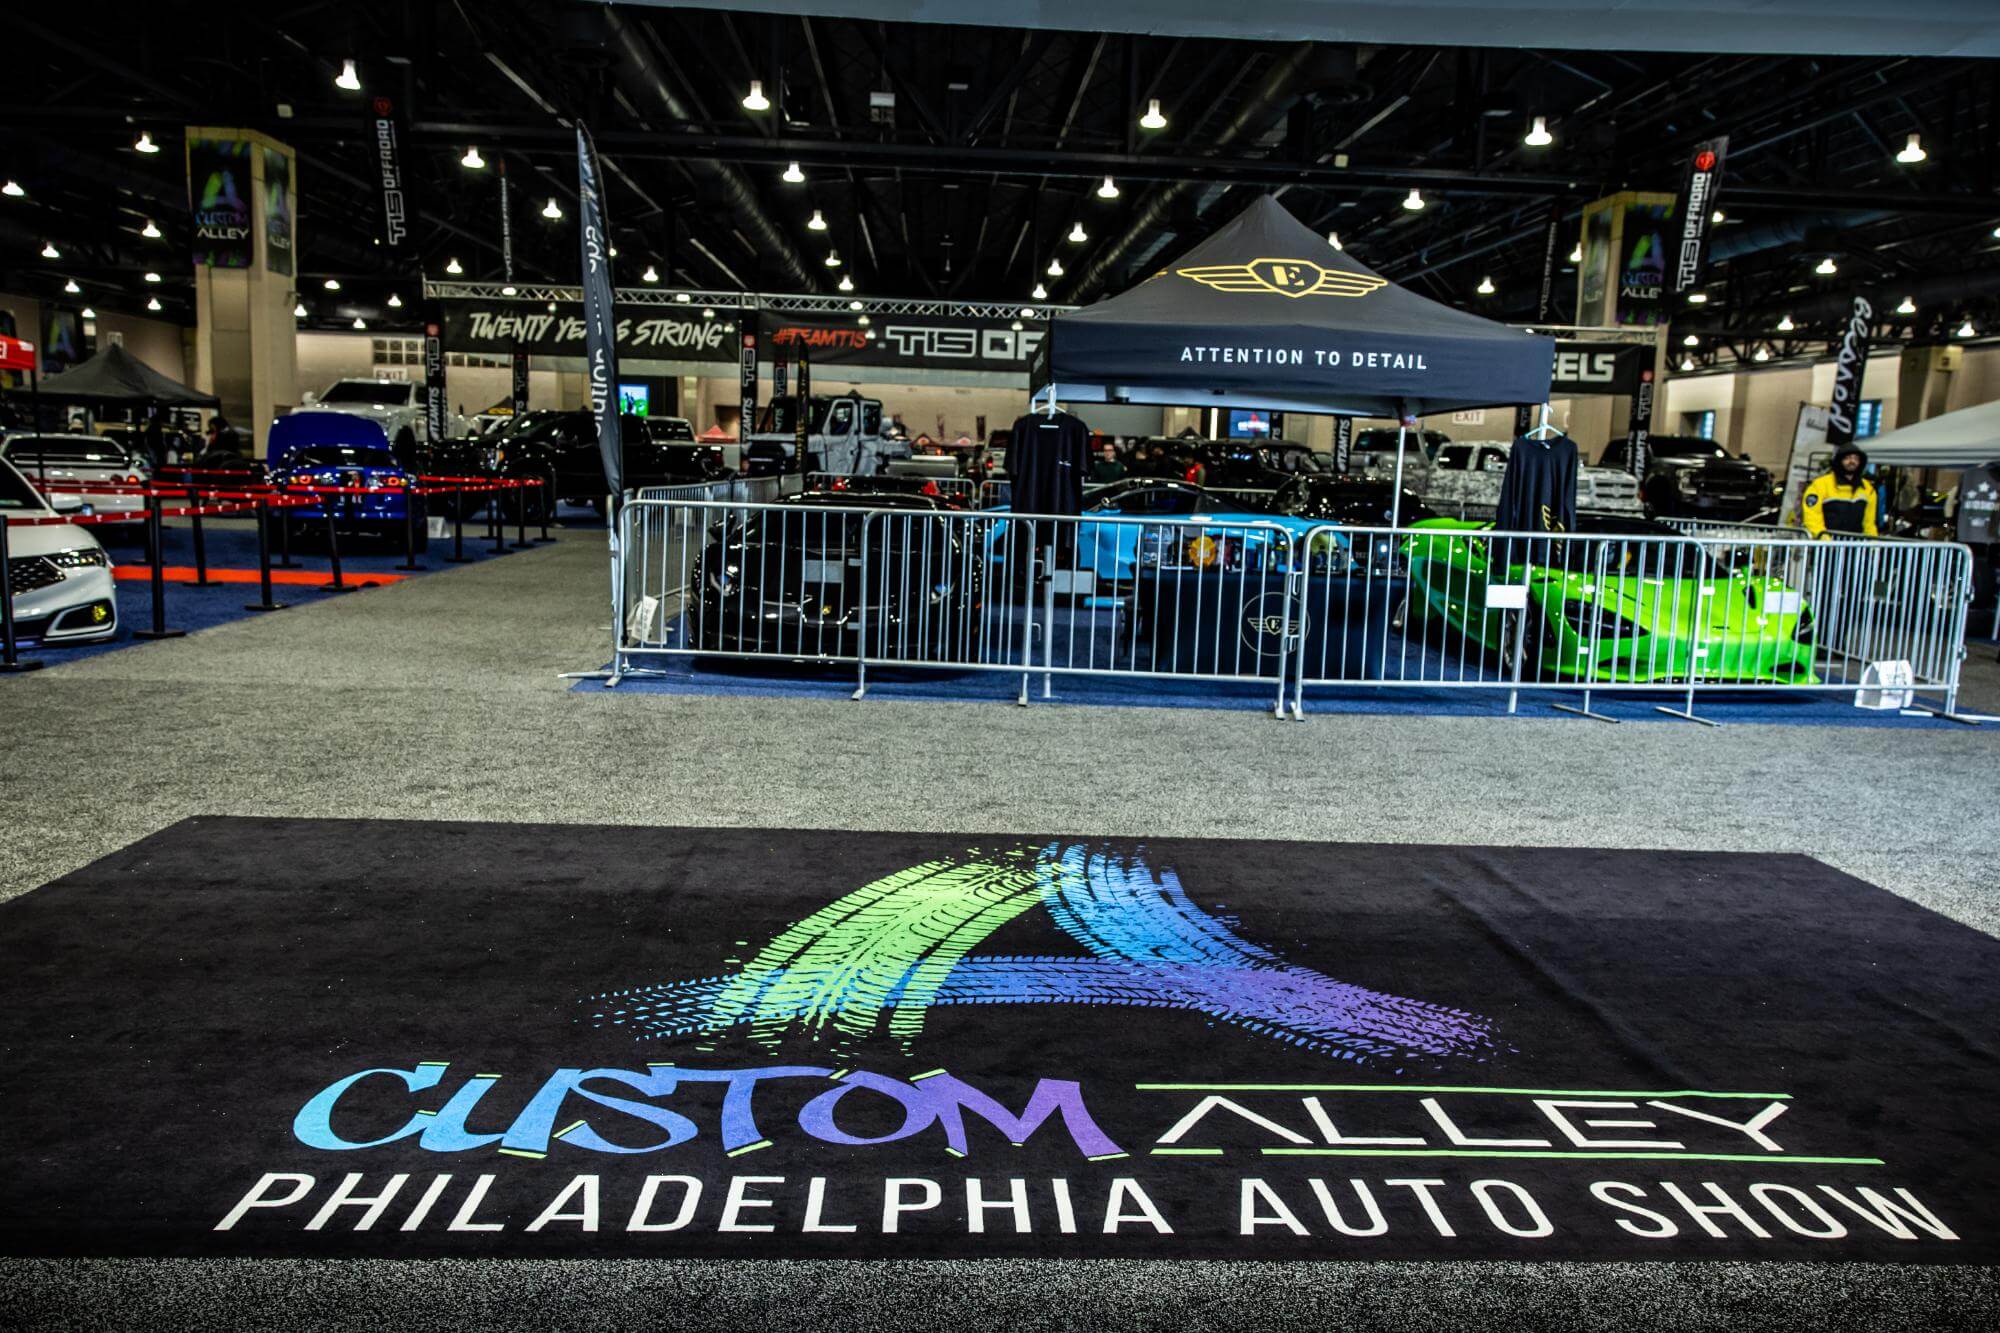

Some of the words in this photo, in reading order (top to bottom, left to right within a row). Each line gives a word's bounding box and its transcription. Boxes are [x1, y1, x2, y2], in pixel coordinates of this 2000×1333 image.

[376, 119, 396, 188] OFFROAD
[1683, 172, 1707, 238] OFFROAD
[197, 227, 249, 239] ALLEY
[469, 312, 554, 344] TWENTY
[632, 318, 724, 350] STRONG
[772, 327, 866, 348] #TEAMTIS
[885, 325, 977, 358] TIS
[1180, 346, 1303, 365] ATTENTION
[1315, 350, 1341, 366] TO
[1352, 352, 1427, 370] DETAIL
[1552, 352, 1616, 382] ELS
[293, 1061, 1130, 1162] CUSTOM
[1155, 1094, 1789, 1152] ALLEY
[213, 1172, 1175, 1235] PHILADELPHIA
[1240, 1177, 1554, 1238] AUTO
[1589, 1181, 1961, 1240] SHOW
